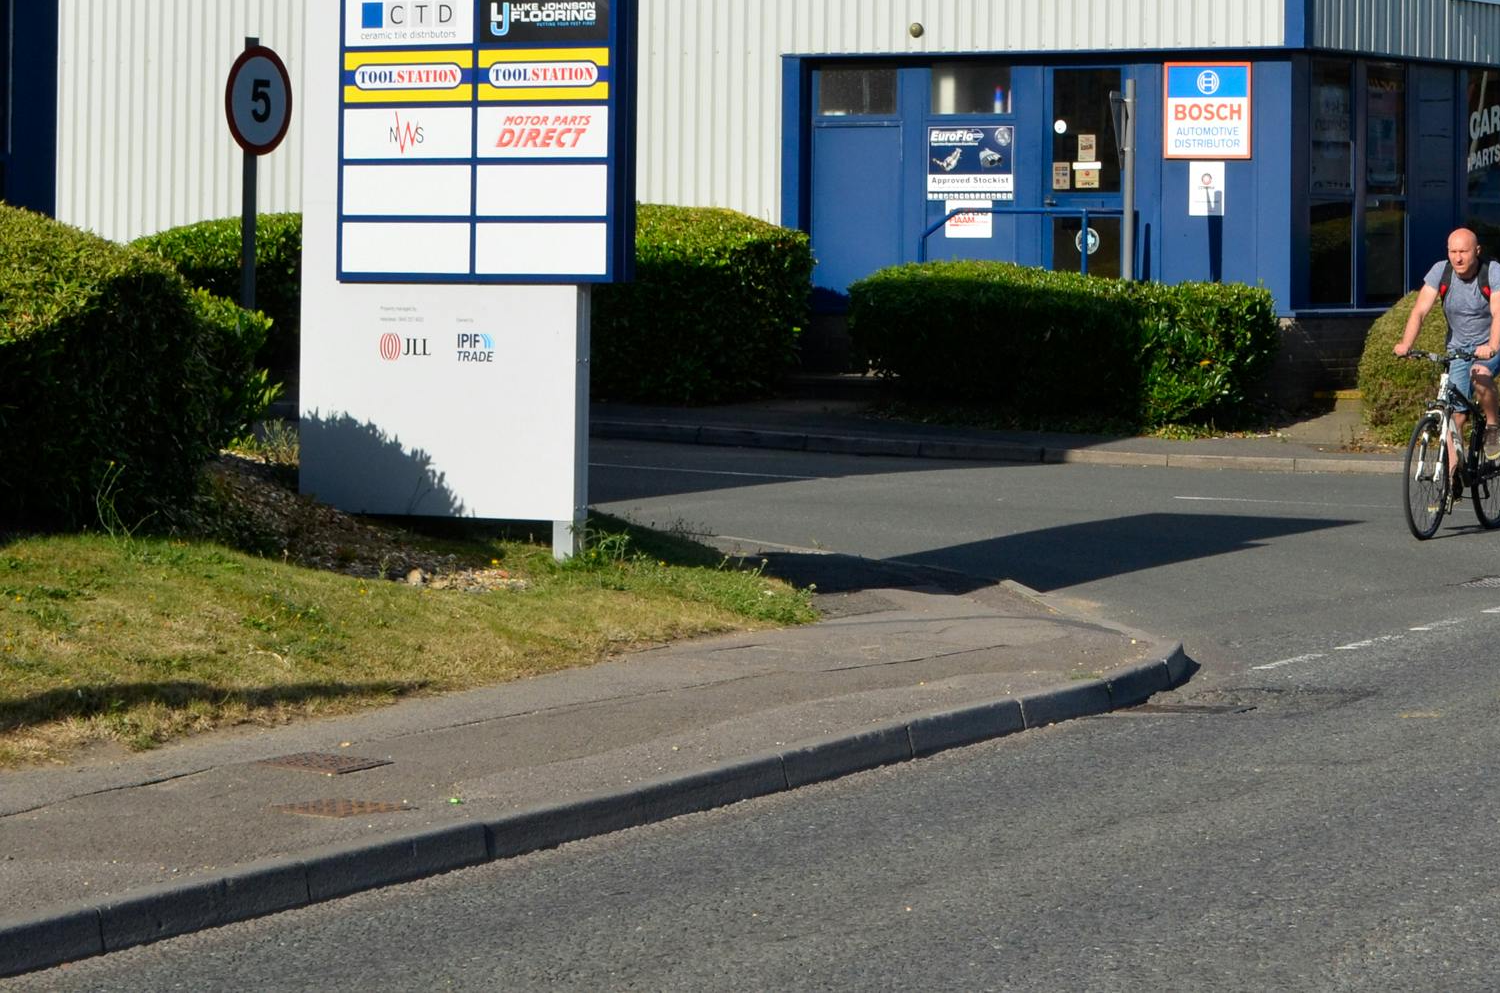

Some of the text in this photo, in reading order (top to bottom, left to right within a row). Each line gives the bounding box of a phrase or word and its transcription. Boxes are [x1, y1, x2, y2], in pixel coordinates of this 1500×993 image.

[511, 1, 596, 11] LUKE JOHNSON
[390, 4, 452, 25] CTD
[510, 9, 597, 22] FLOORING
[361, 30, 457, 40] ceramic tile distributors
[358, 68, 459, 84] TOOLSTATION
[493, 66, 594, 82] TOOLSTATION
[251, 78, 271, 123] 5
[1174, 103, 1242, 121] BOSCH
[504, 115, 592, 126] MOTOR PARTS
[1469, 105, 1500, 141] CAR
[495, 128, 588, 148] DIRECT
[1176, 126, 1240, 136] AUTOMOTIVE
[1174, 138, 1241, 149] DISTRIBUTOR
[1470, 144, 1500, 172] PARTS
[932, 176, 1009, 185] Approved Stockist
[402, 338, 431, 355] JLL
[457, 333, 480, 348] IPIF
[457, 351, 494, 362] TRADE
